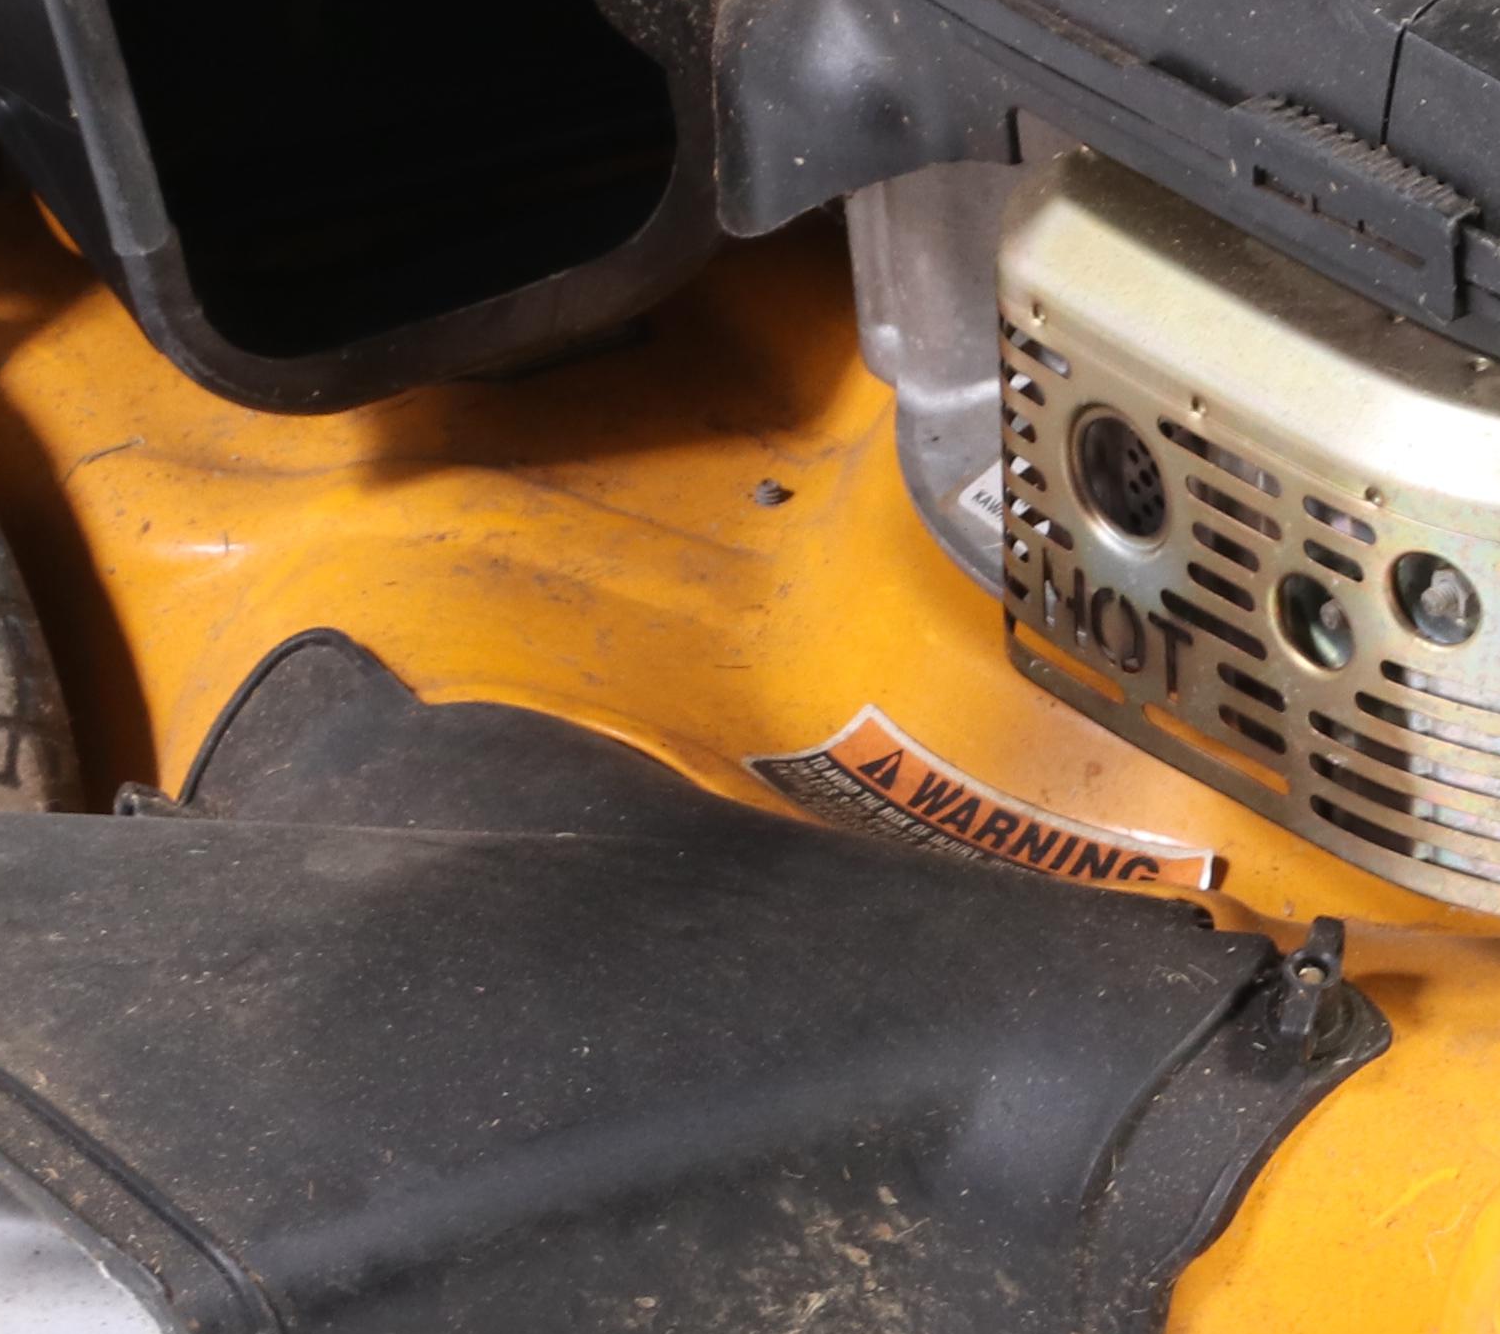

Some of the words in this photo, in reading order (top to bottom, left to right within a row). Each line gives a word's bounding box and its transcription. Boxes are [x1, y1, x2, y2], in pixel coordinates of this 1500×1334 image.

[1040, 547, 1196, 701] HOT
[820, 768, 863, 796] AVOID
[857, 790, 886, 811] THE
[876, 805, 916, 828] RISK
[908, 823, 934, 839] OF
[906, 770, 1161, 881] WARNING
